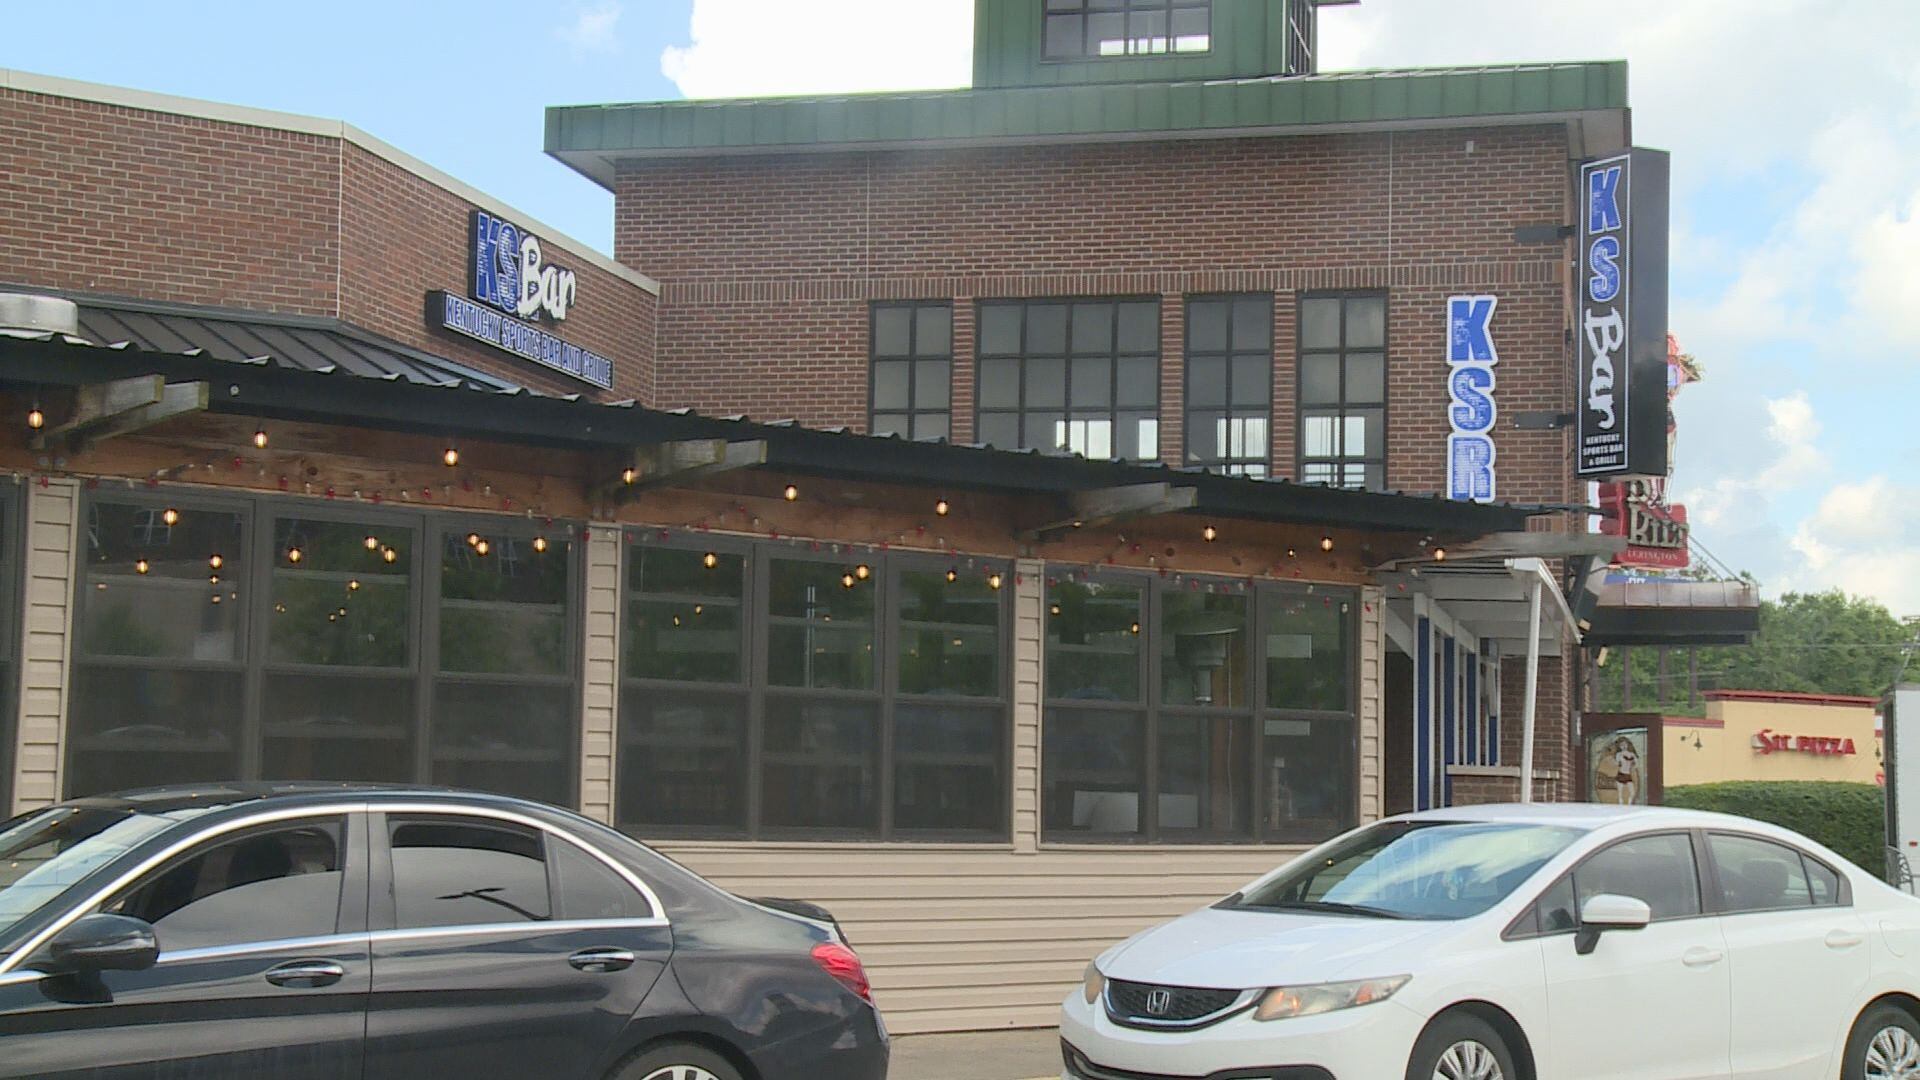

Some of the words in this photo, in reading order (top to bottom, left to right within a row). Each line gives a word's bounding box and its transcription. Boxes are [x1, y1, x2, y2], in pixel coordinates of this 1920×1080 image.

[517, 235, 577, 321] Bar
[445, 294, 502, 343] KENTUCKY
[502, 317, 541, 360] SPORTS
[541, 330, 563, 368] BAR
[562, 341, 582, 376] AND
[1584, 307, 1625, 430] Bar
[1446, 295, 1498, 504] KSR
[1585, 433, 1620, 445] KENTUCKY
[1583, 445, 1609, 456] SPORTS
[1609, 443, 1623, 453] BAR
[1628, 502, 1690, 549] KILT
